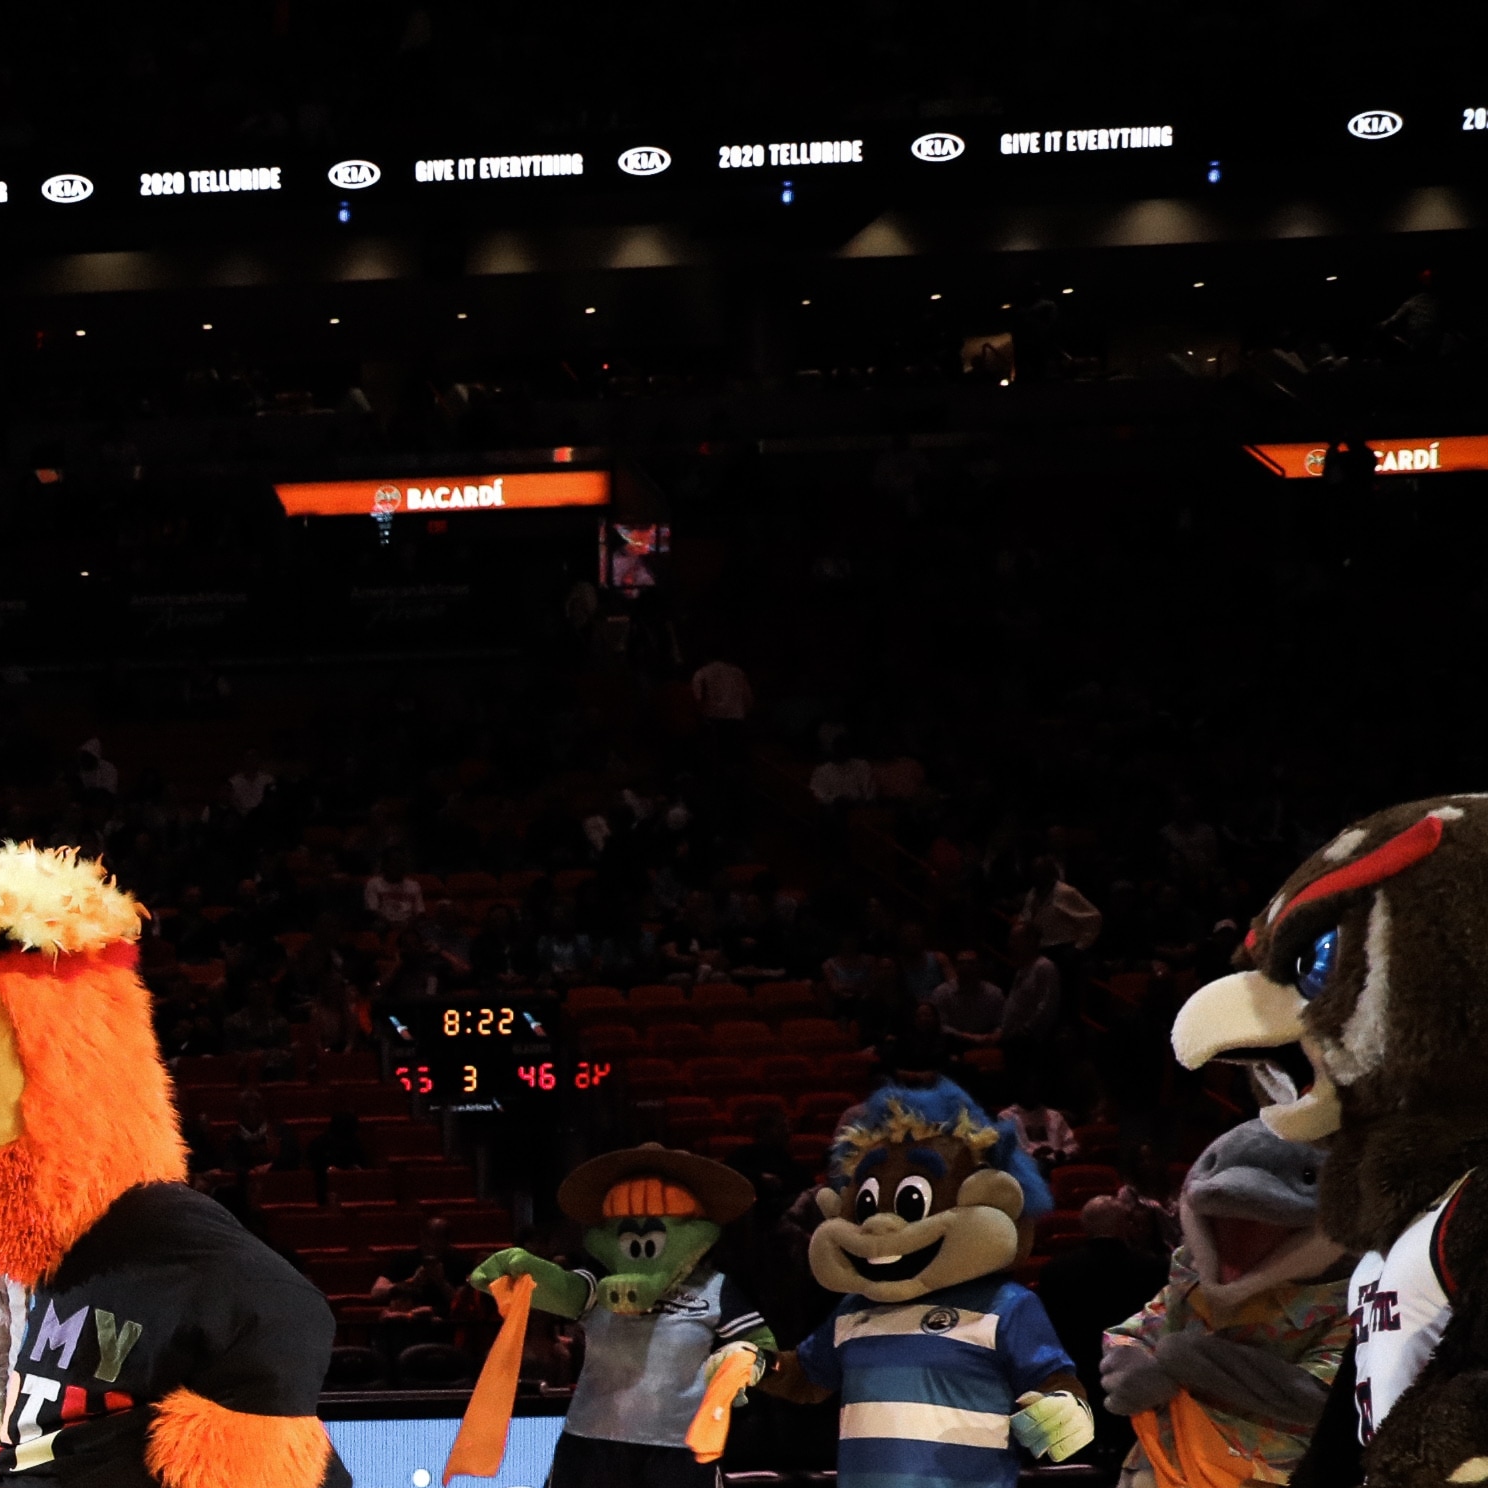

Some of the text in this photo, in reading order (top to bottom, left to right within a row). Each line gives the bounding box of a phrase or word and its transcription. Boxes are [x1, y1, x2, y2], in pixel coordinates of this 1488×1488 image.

[1462, 107, 1488, 131] 20
[1000, 125, 1173, 155] GIVE IT EVERYTHING
[414, 152, 584, 183] GIVE IT EVERYTHING
[1373, 441, 1441, 471] CARDÍ
[443, 1007, 515, 1037] 8:22
[463, 1065, 478, 1093] 3
[517, 1062, 557, 1091] 46
